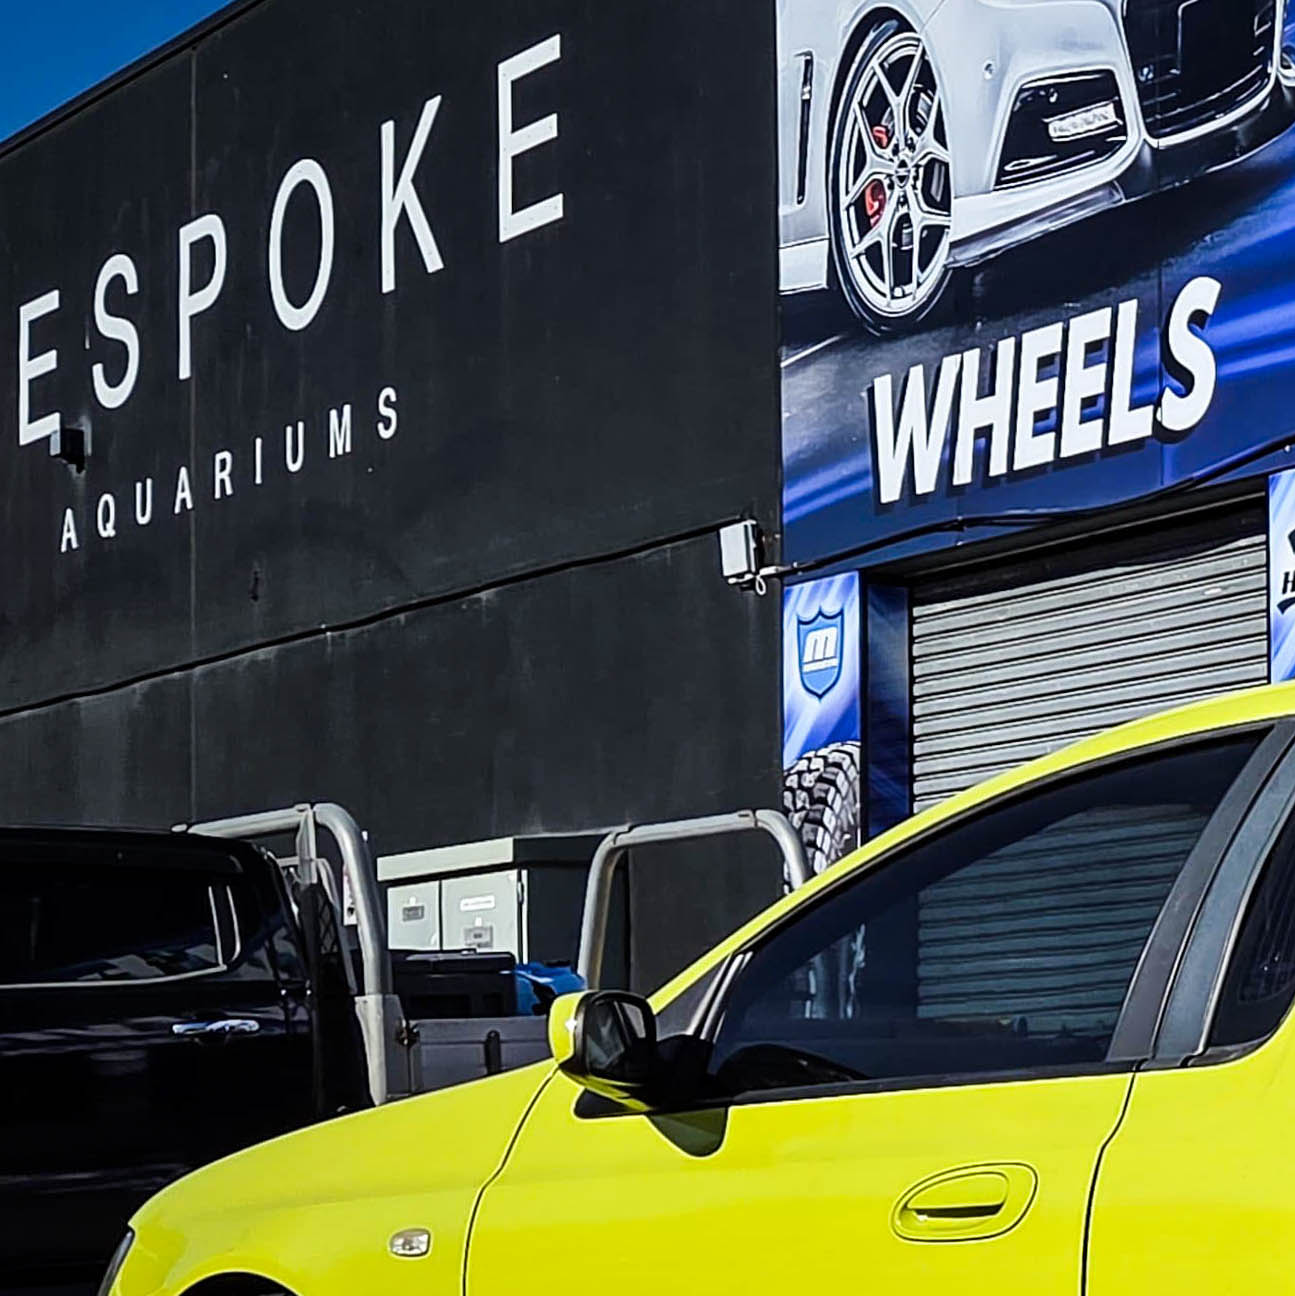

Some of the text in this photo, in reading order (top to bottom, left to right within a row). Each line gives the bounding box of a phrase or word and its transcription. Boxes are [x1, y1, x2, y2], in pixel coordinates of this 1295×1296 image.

[19, 34, 564, 446] ESPOKE
[60, 387, 397, 553] AQUARIUMS
[873, 276, 1221, 503] WHEELS
